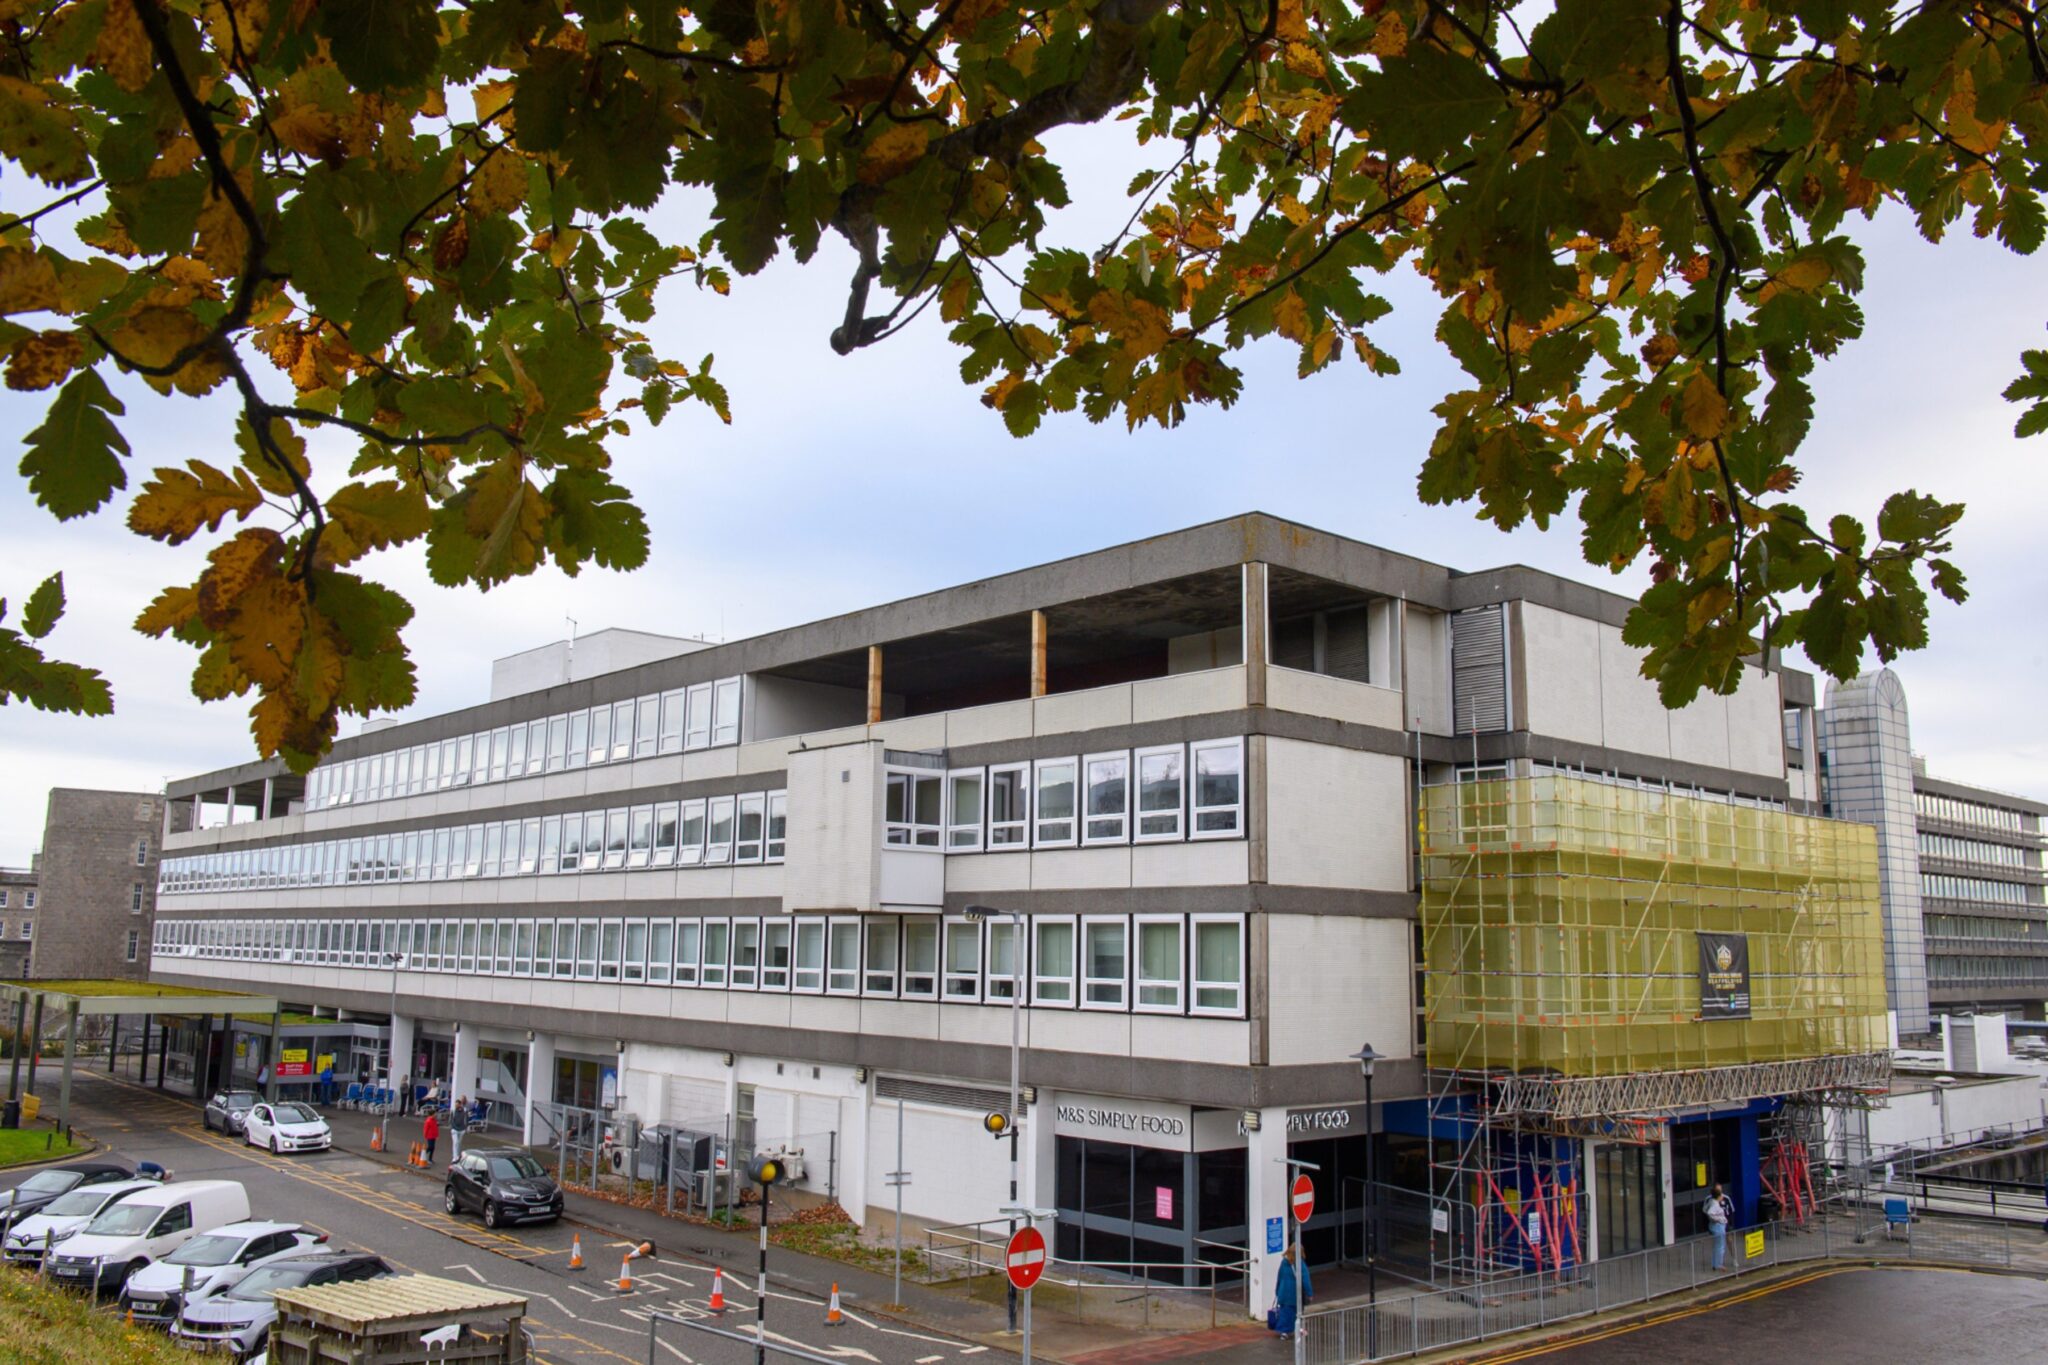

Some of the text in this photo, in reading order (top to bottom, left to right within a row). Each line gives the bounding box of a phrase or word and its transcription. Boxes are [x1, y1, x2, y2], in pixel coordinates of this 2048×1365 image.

[1057, 1105, 1184, 1136] M&S SIMPLY FOOD
[1286, 1110, 1350, 1132] MPLY FOOD
